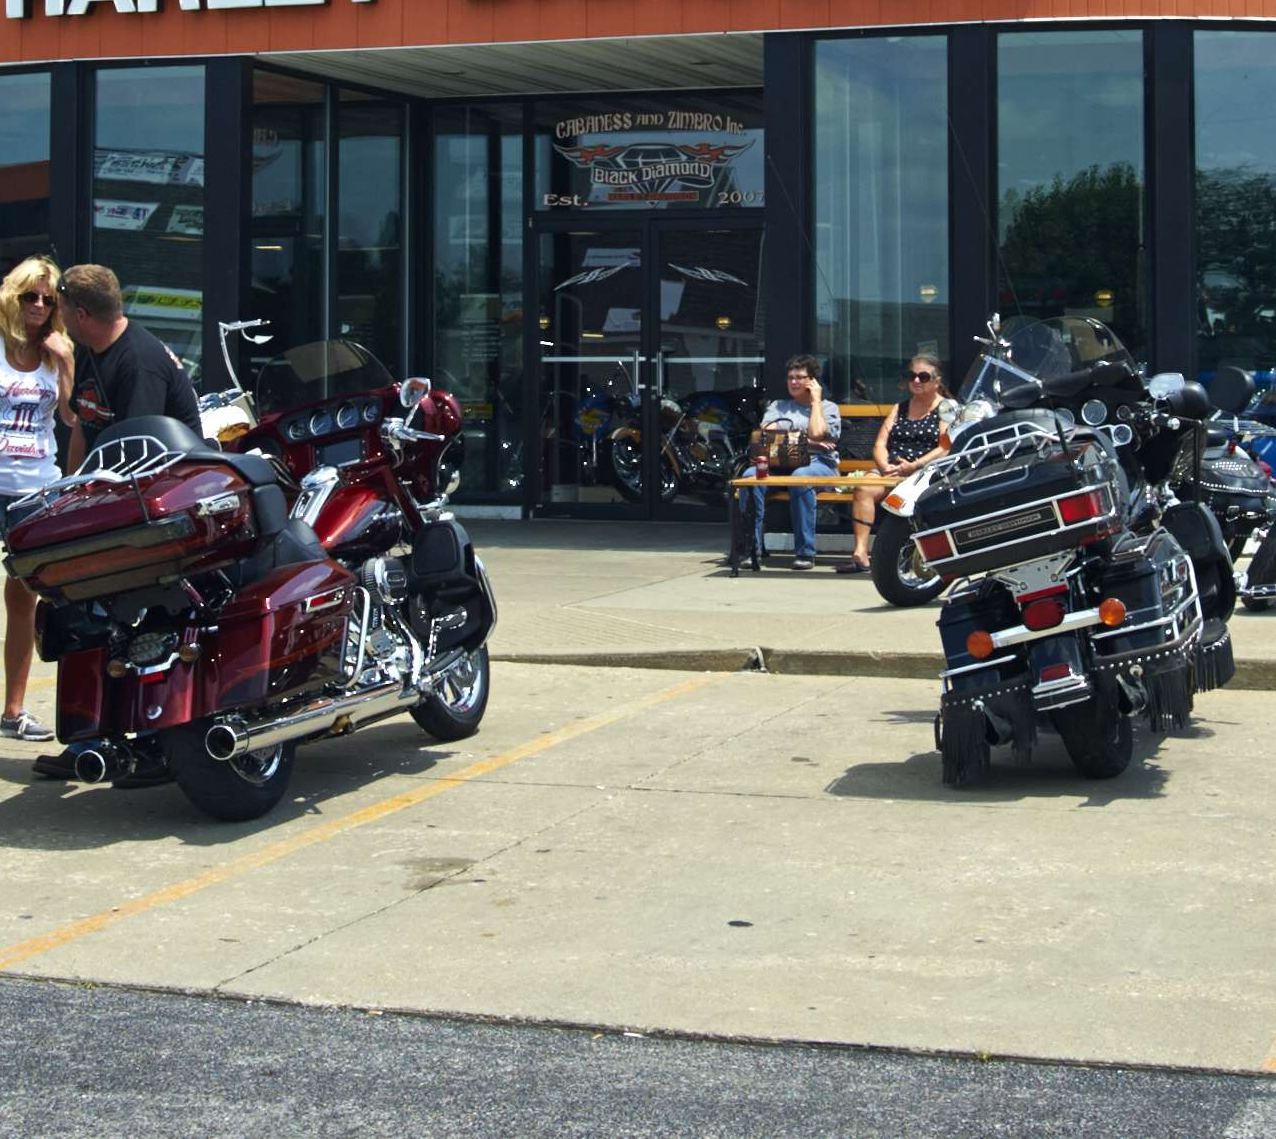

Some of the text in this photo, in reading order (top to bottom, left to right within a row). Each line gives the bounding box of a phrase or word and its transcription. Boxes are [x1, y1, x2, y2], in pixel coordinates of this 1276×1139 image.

[556, 112, 632, 139] CABANESS
[667, 110, 723, 132] ZIMBRO
[543, 193, 589, 207] Est.
